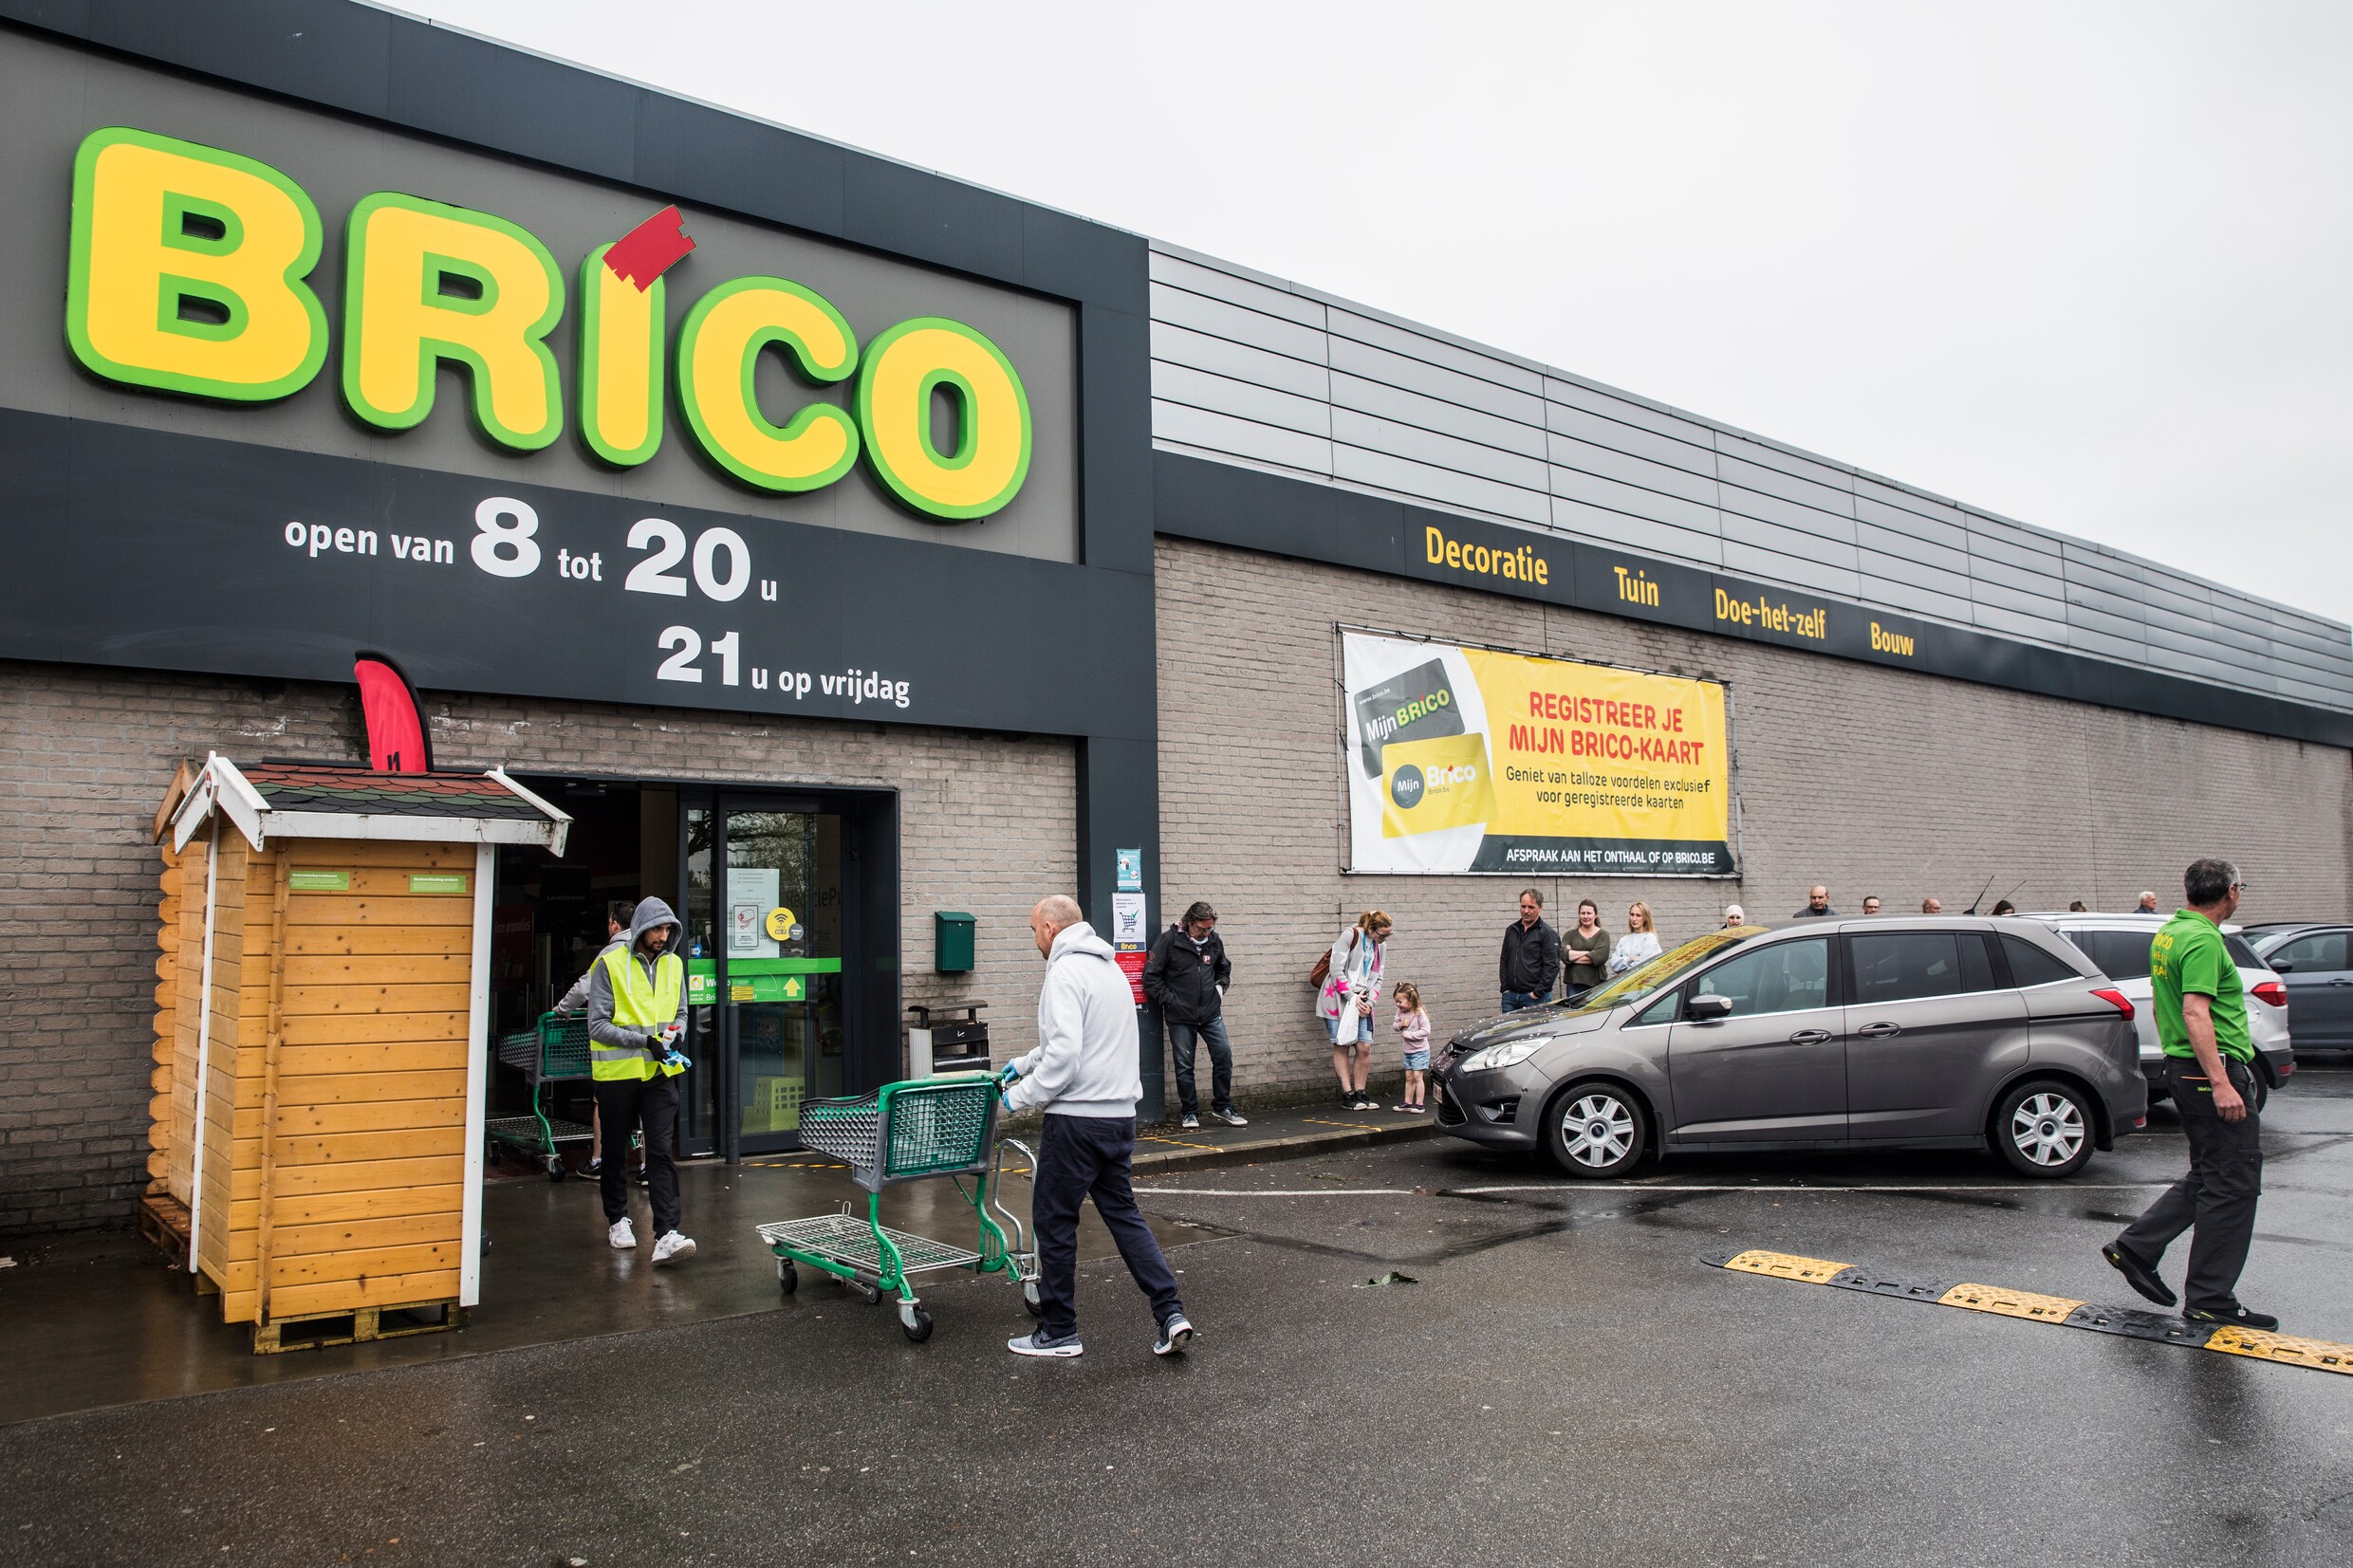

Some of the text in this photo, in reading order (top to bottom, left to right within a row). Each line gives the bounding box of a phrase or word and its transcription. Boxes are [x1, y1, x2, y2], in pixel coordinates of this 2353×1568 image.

[284, 496, 777, 602] open van 8 tot 20 u
[1425, 526, 1915, 656] Decoratie Tuin Doe-het-zelf Bouw
[657, 625, 910, 709] 21 u op vrijdag
[1359, 687, 1391, 706] www.brico.be
[1529, 691, 1683, 733] REGISTREER JE
[1510, 724, 1704, 766] MIJN BRICO-KAART
[1398, 780, 1419, 793] Mijn
[1427, 765, 1476, 787] Brico
[1506, 766, 1711, 793] Geniet van talloze voordelen exclusief
[1536, 789, 1684, 810] voor geregistreerde kaarten
[1507, 849, 1715, 865] AFSPRAAK AAN HET ONTHAAL OF OP BRICO.BE
